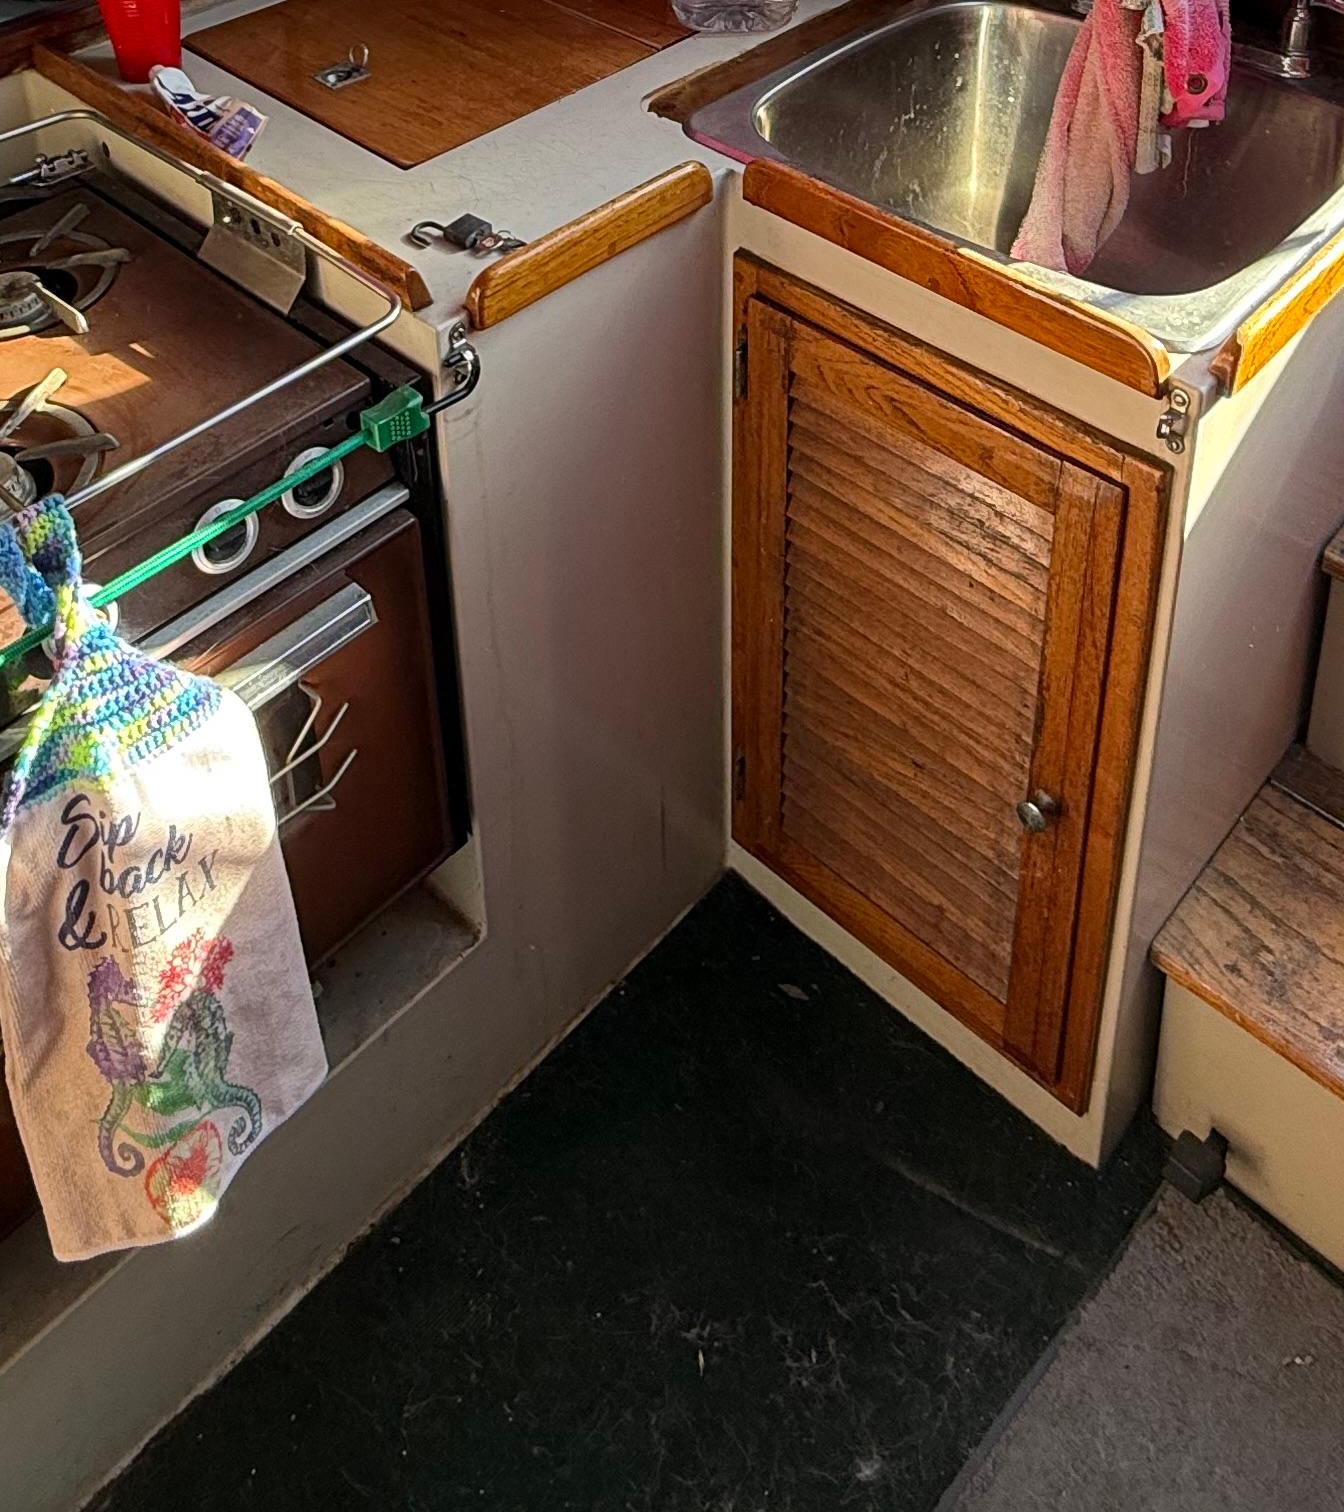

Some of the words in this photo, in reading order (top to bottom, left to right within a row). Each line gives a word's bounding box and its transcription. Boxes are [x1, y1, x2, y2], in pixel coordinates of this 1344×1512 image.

[56, 792, 142, 869] Sip
[99, 824, 194, 899] back
[57, 878, 108, 952] &
[106, 848, 220, 953] RELAX
